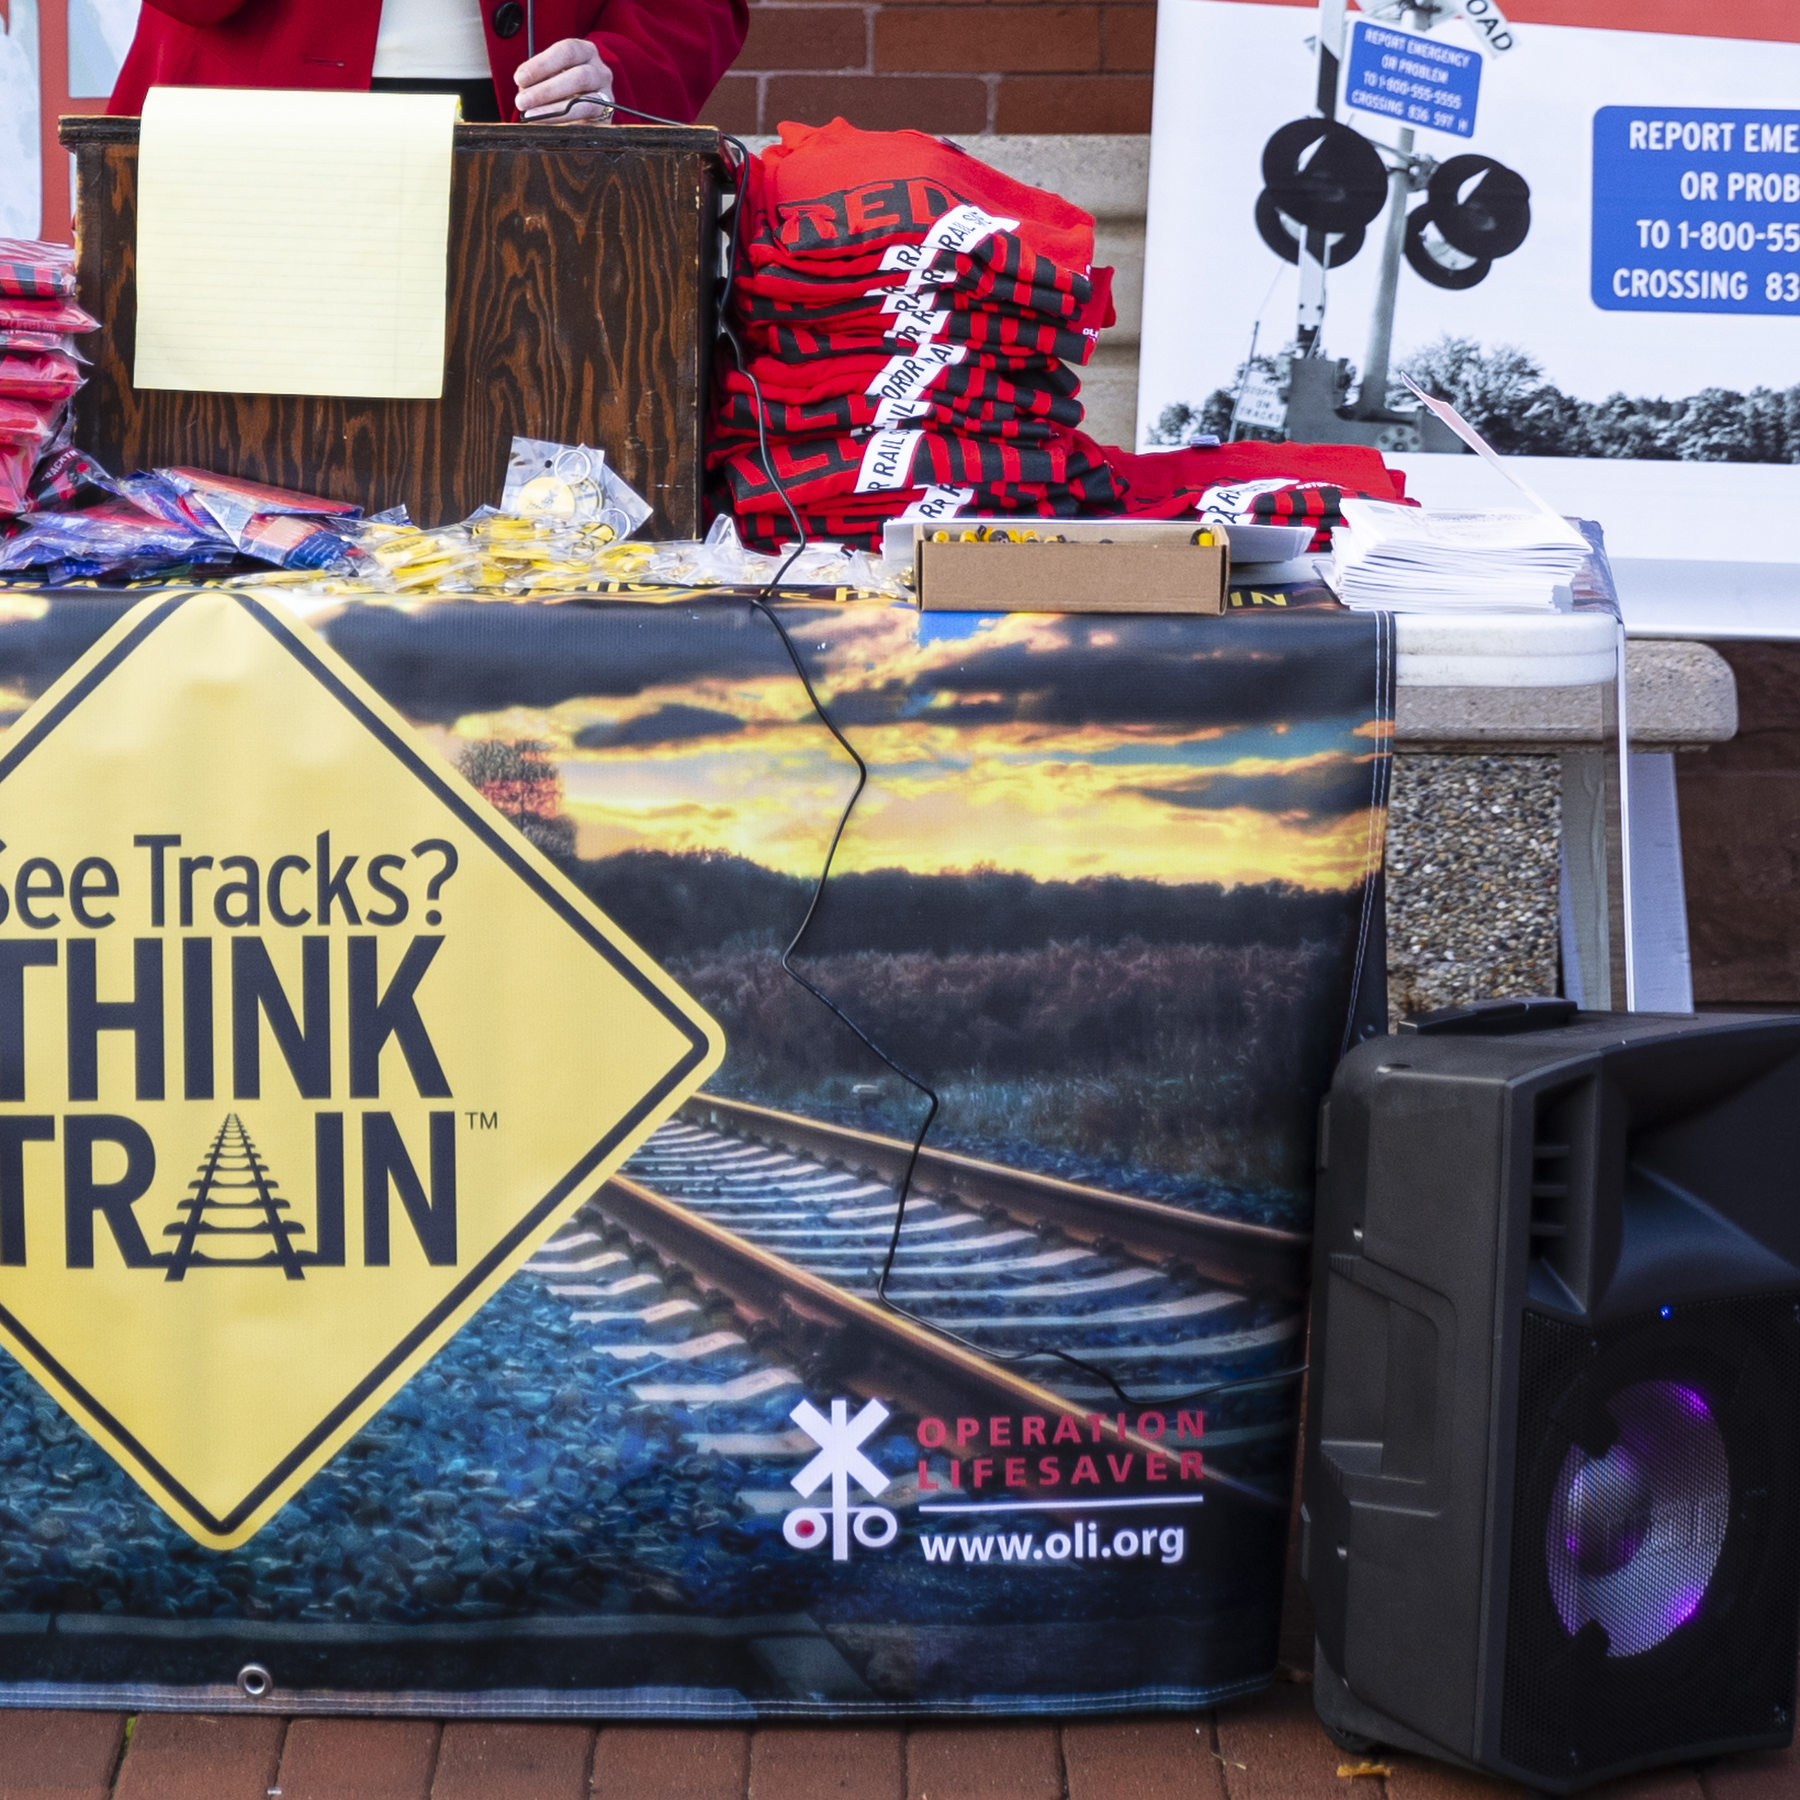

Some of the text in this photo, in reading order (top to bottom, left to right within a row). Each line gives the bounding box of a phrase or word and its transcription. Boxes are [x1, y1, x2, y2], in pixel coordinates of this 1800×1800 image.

[1363, 27, 1473, 69] REPORT EMERGENCY
[1398, 57, 1450, 85] PROBLEM
[1628, 119, 1736, 152] REPORT
[1679, 170, 1719, 202] OR
[1635, 218, 1671, 250] TO
[1611, 266, 1750, 302] CROSSING
[133, 829, 459, 929] Tracks?
[916, 1409, 1205, 1449] OPERATION
[917, 1450, 1205, 1491] LIFESAVER
[919, 1522, 1185, 1564] www.oli.org
